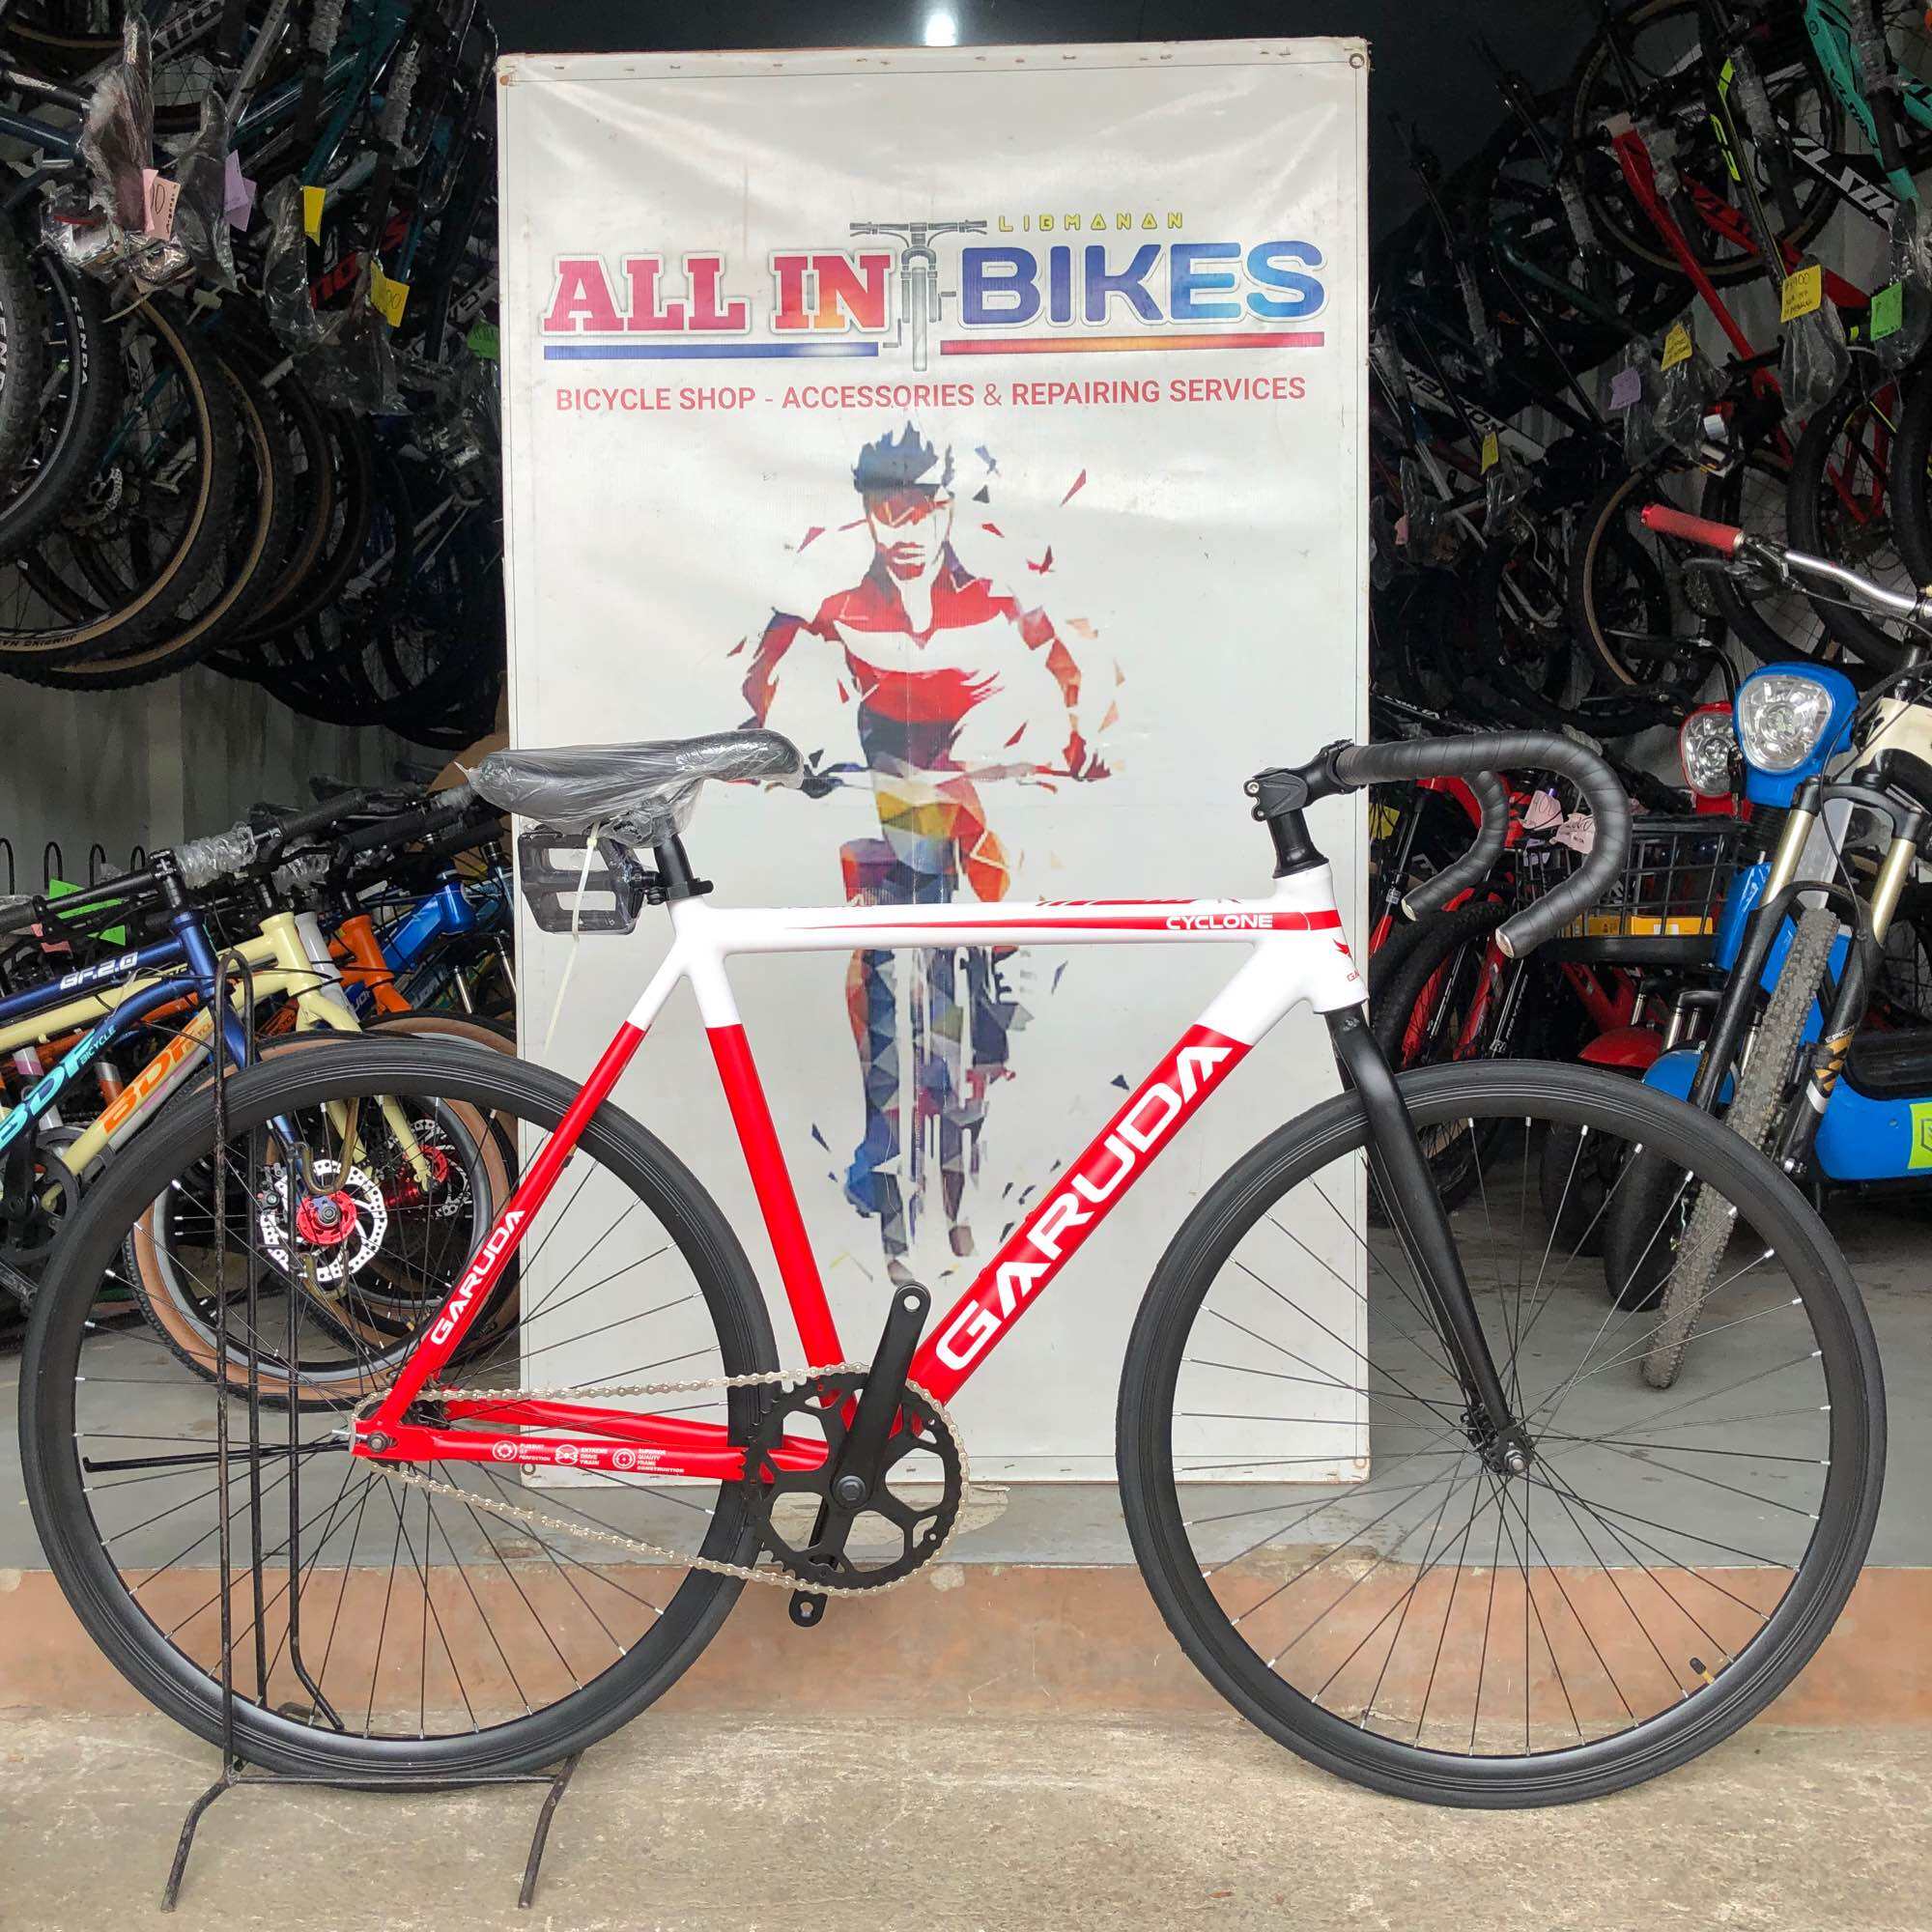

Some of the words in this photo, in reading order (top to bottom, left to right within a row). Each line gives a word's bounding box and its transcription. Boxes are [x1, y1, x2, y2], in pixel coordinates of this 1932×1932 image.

[998, 212, 1183, 233] LIBMANAN
[543, 258, 747, 331] ALL
[773, 254, 892, 329] IN
[960, 241, 1325, 325] BIKES
[71, 296, 88, 385] KENDA
[555, 387, 671, 411] BICYCLE
[679, 386, 756, 410] SHOP
[781, 384, 975, 410] ACCESSORIES
[983, 383, 1003, 407] &
[1011, 380, 1160, 407] REPAIRING
[1169, 376, 1306, 403] SERVICES
[1165, 913, 1274, 930] CYCLONE
[79, 1024, 117, 1065] BICYCLE
[935, 1046, 1234, 1371] GARUDA
[430, 1209, 526, 1345] GARUDA
